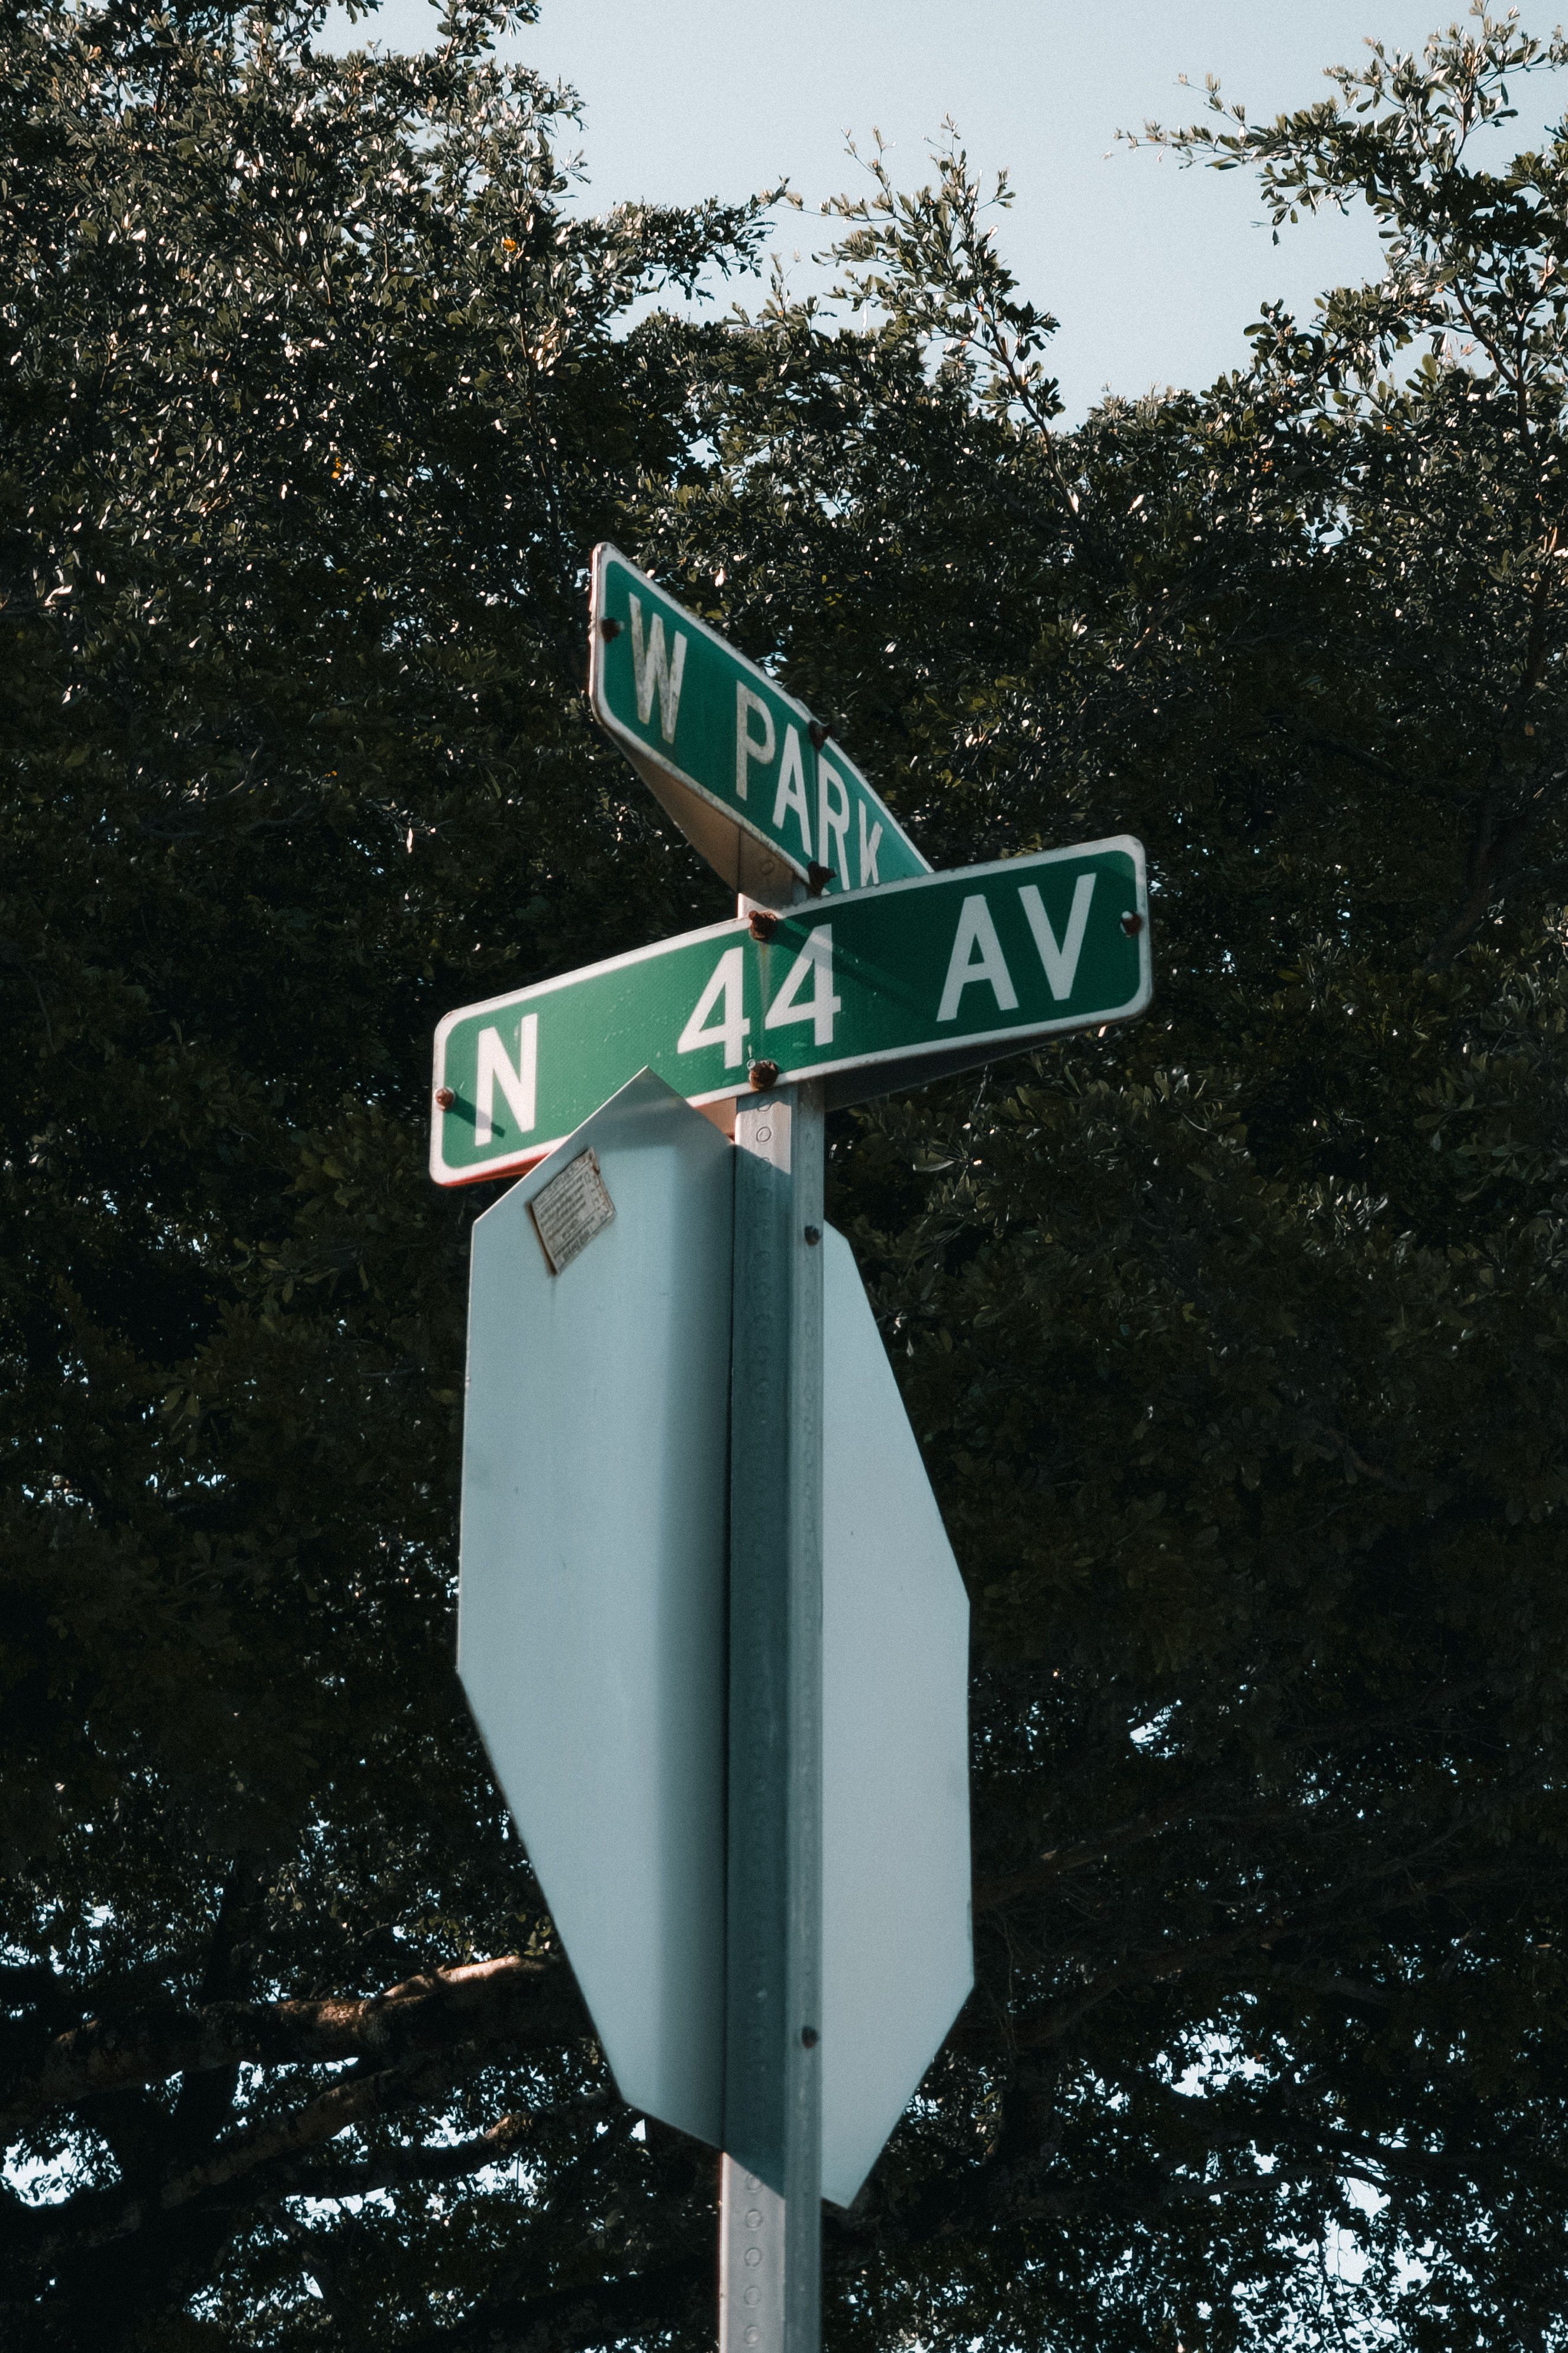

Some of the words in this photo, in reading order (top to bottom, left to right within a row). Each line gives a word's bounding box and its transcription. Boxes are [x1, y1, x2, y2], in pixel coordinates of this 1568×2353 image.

[628, 592, 688, 744] W
[735, 680, 883, 895] PARK
[475, 1013, 538, 1147] N
[676, 924, 841, 1069] 44
[936, 872, 1098, 1023] AV
